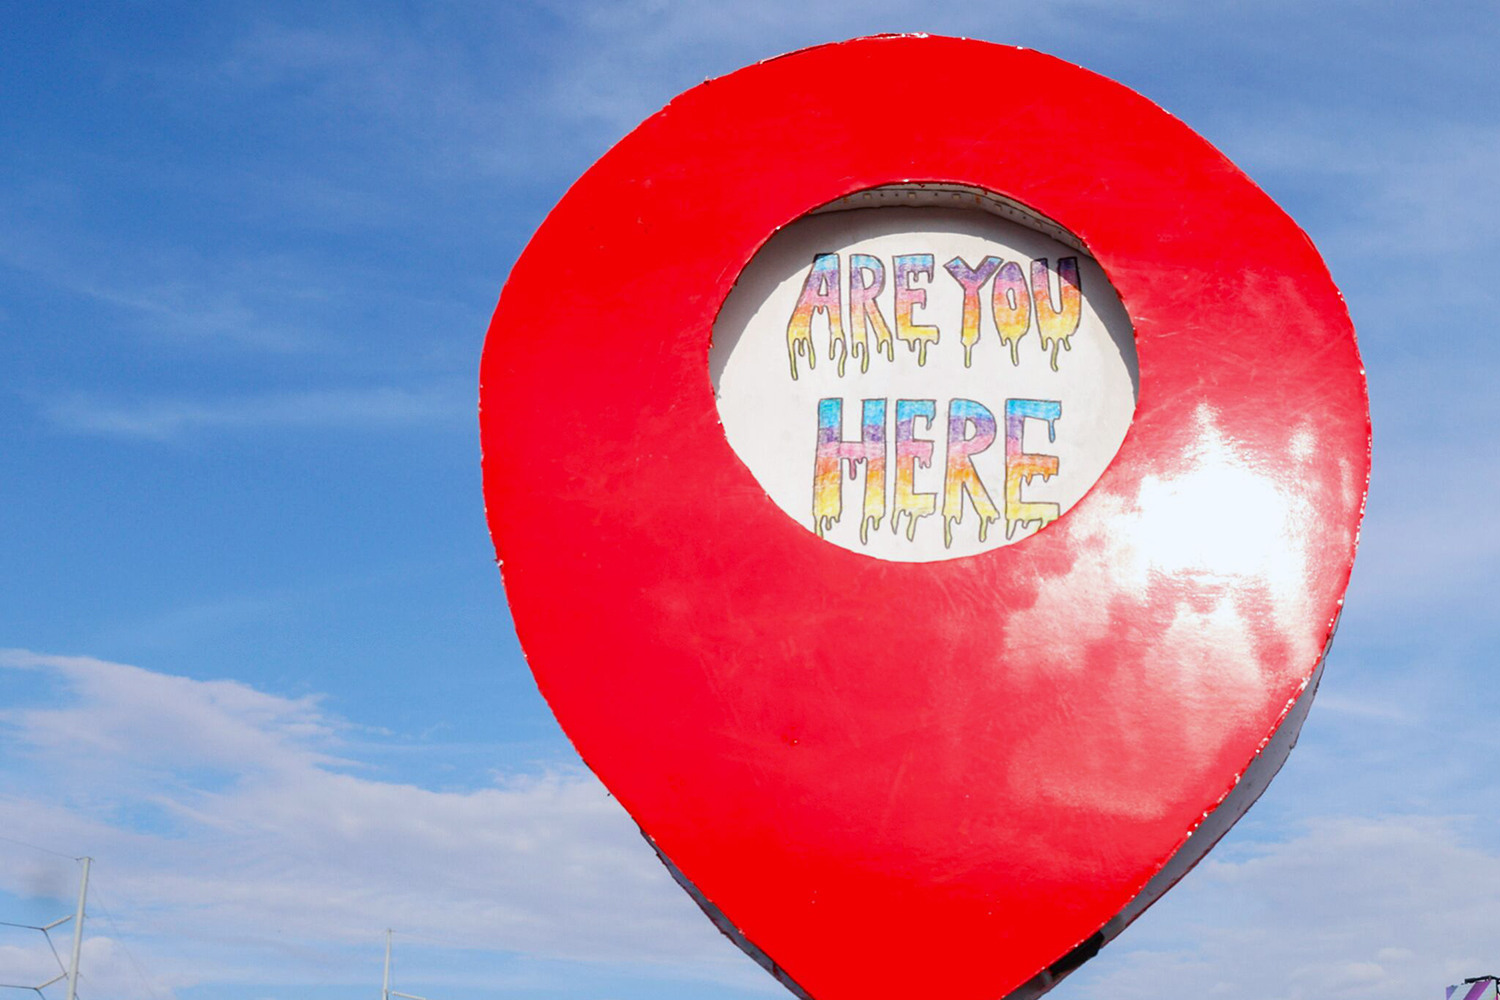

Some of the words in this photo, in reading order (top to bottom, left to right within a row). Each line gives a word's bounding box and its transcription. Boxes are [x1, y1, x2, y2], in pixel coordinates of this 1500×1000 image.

[786, 253, 940, 381] ARE
[943, 255, 1082, 372] YOU
[812, 398, 1062, 549] HERE
